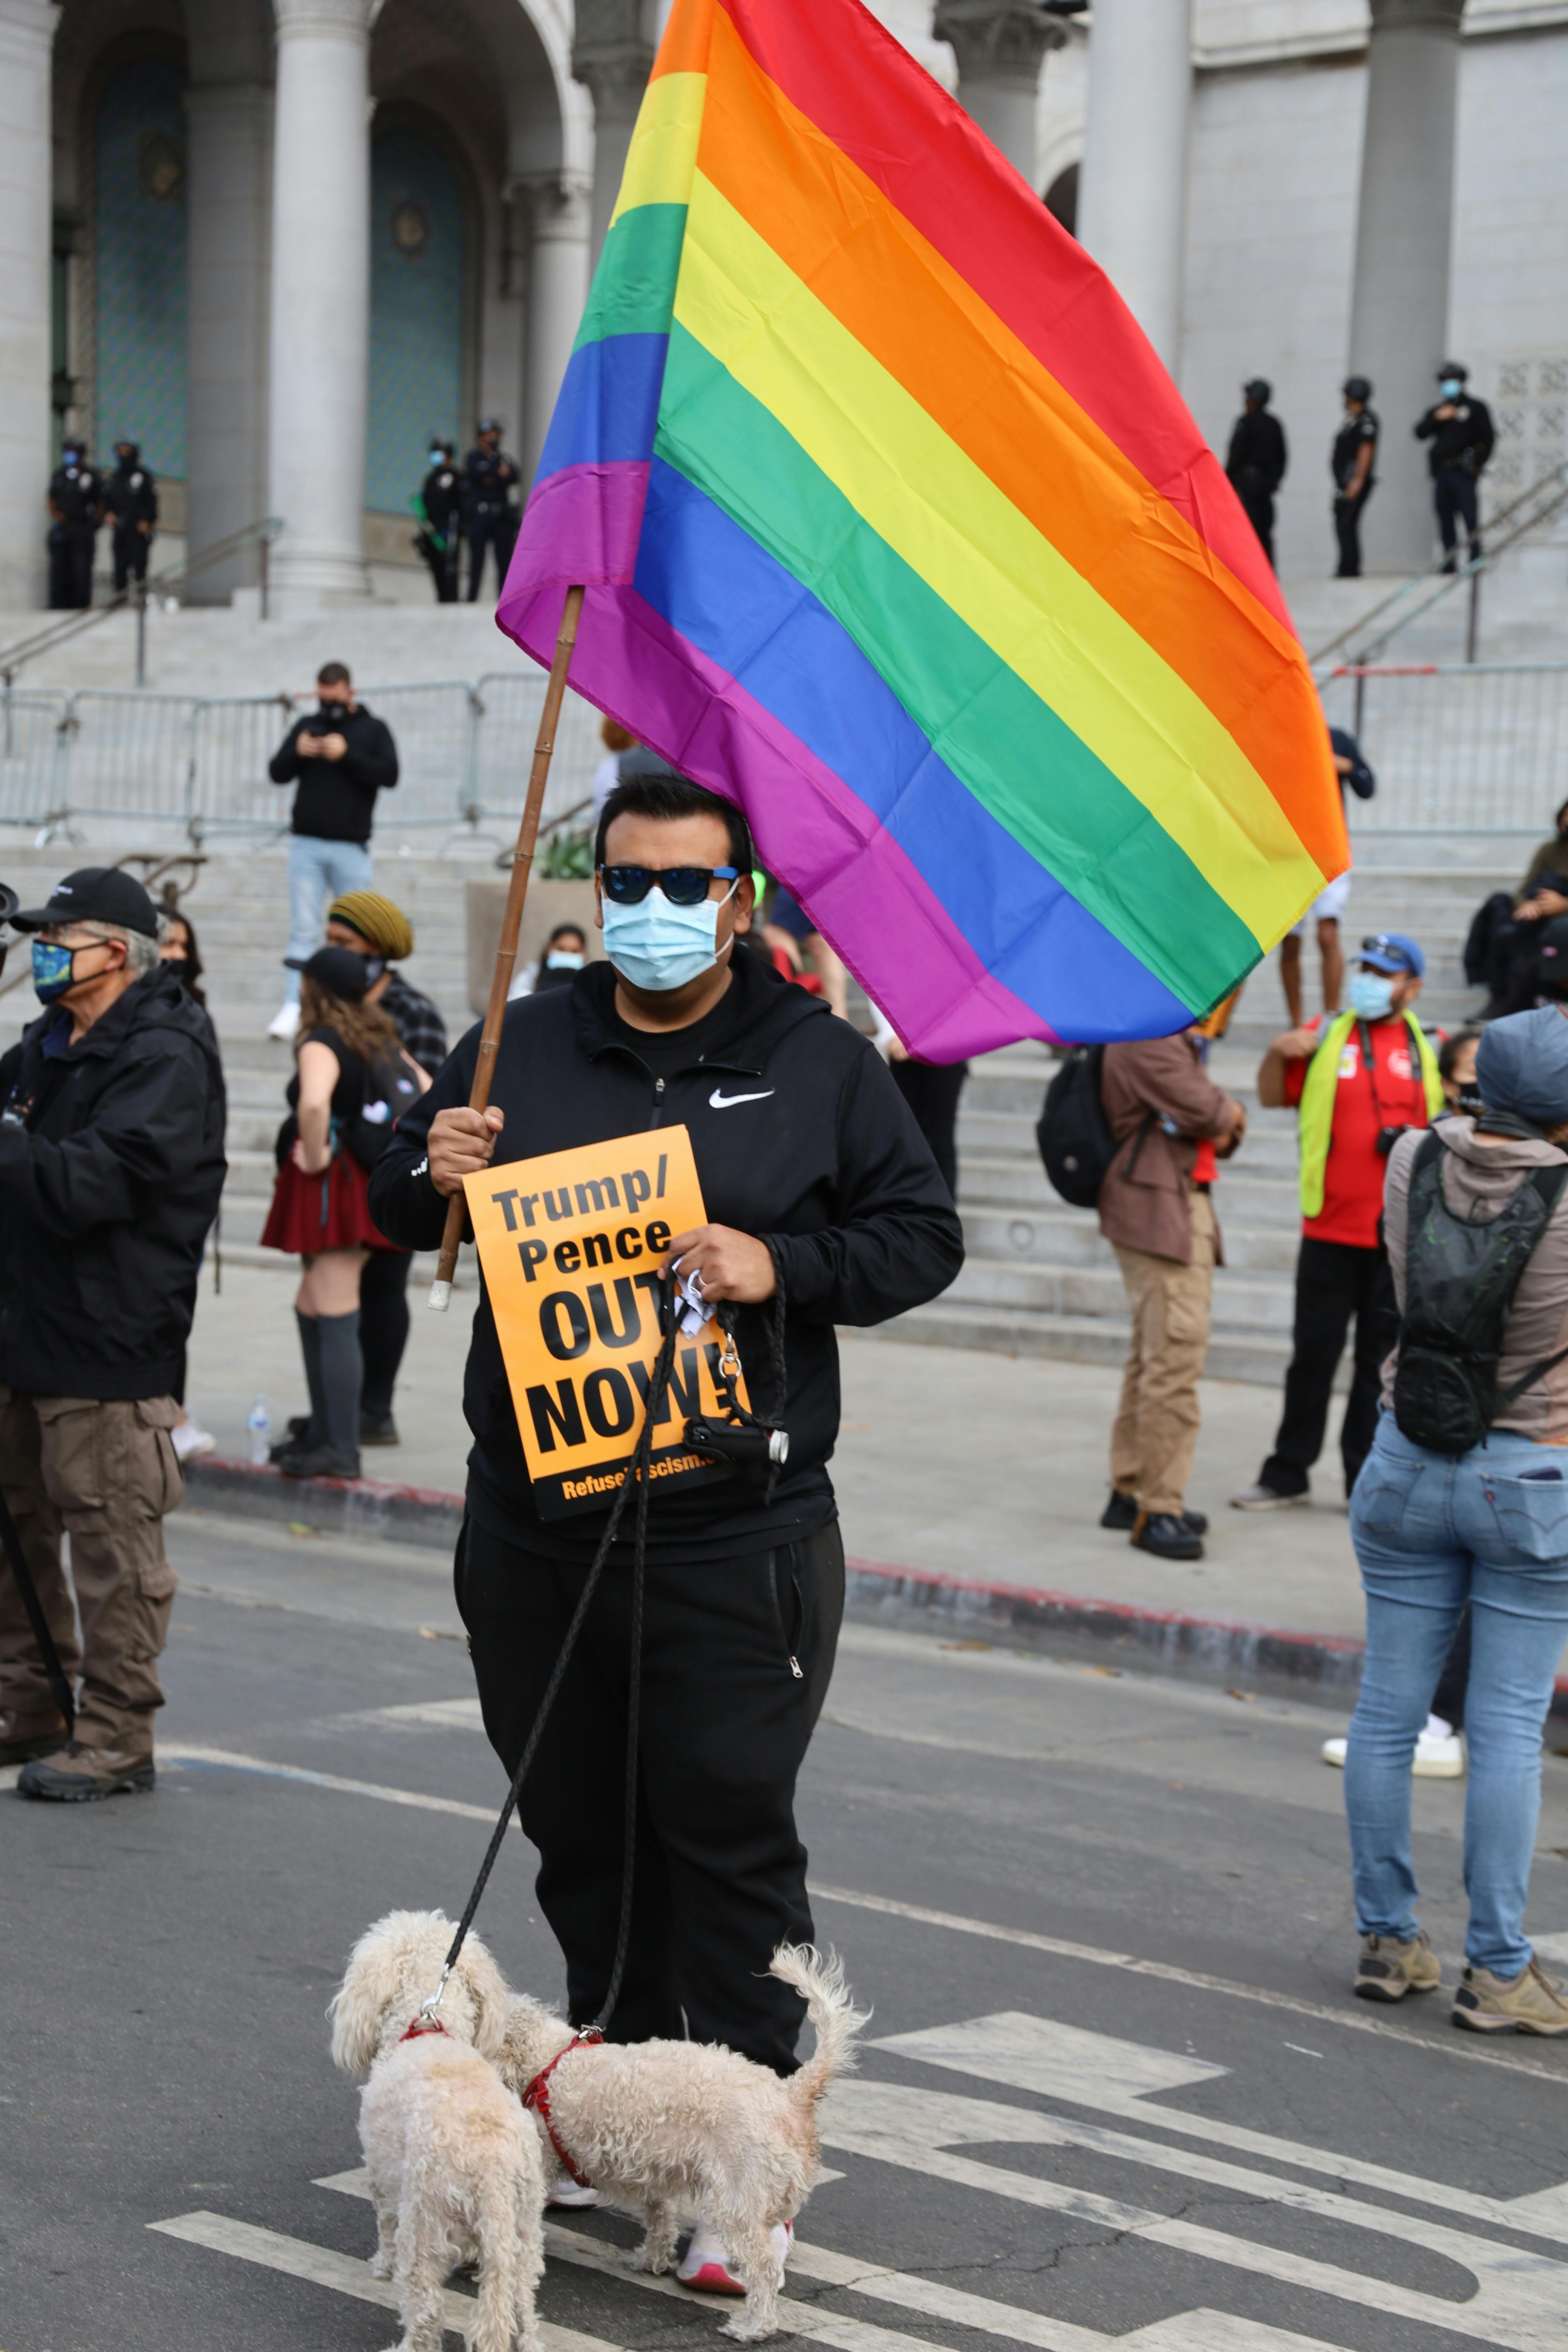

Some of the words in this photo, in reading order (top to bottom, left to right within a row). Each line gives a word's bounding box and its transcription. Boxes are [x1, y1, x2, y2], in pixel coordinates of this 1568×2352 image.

[491, 1153, 668, 1232] Trump/
[518, 1220, 672, 1283] Pence
[539, 1270, 669, 1360] OUT
[525, 1342, 733, 1454] NOW!
